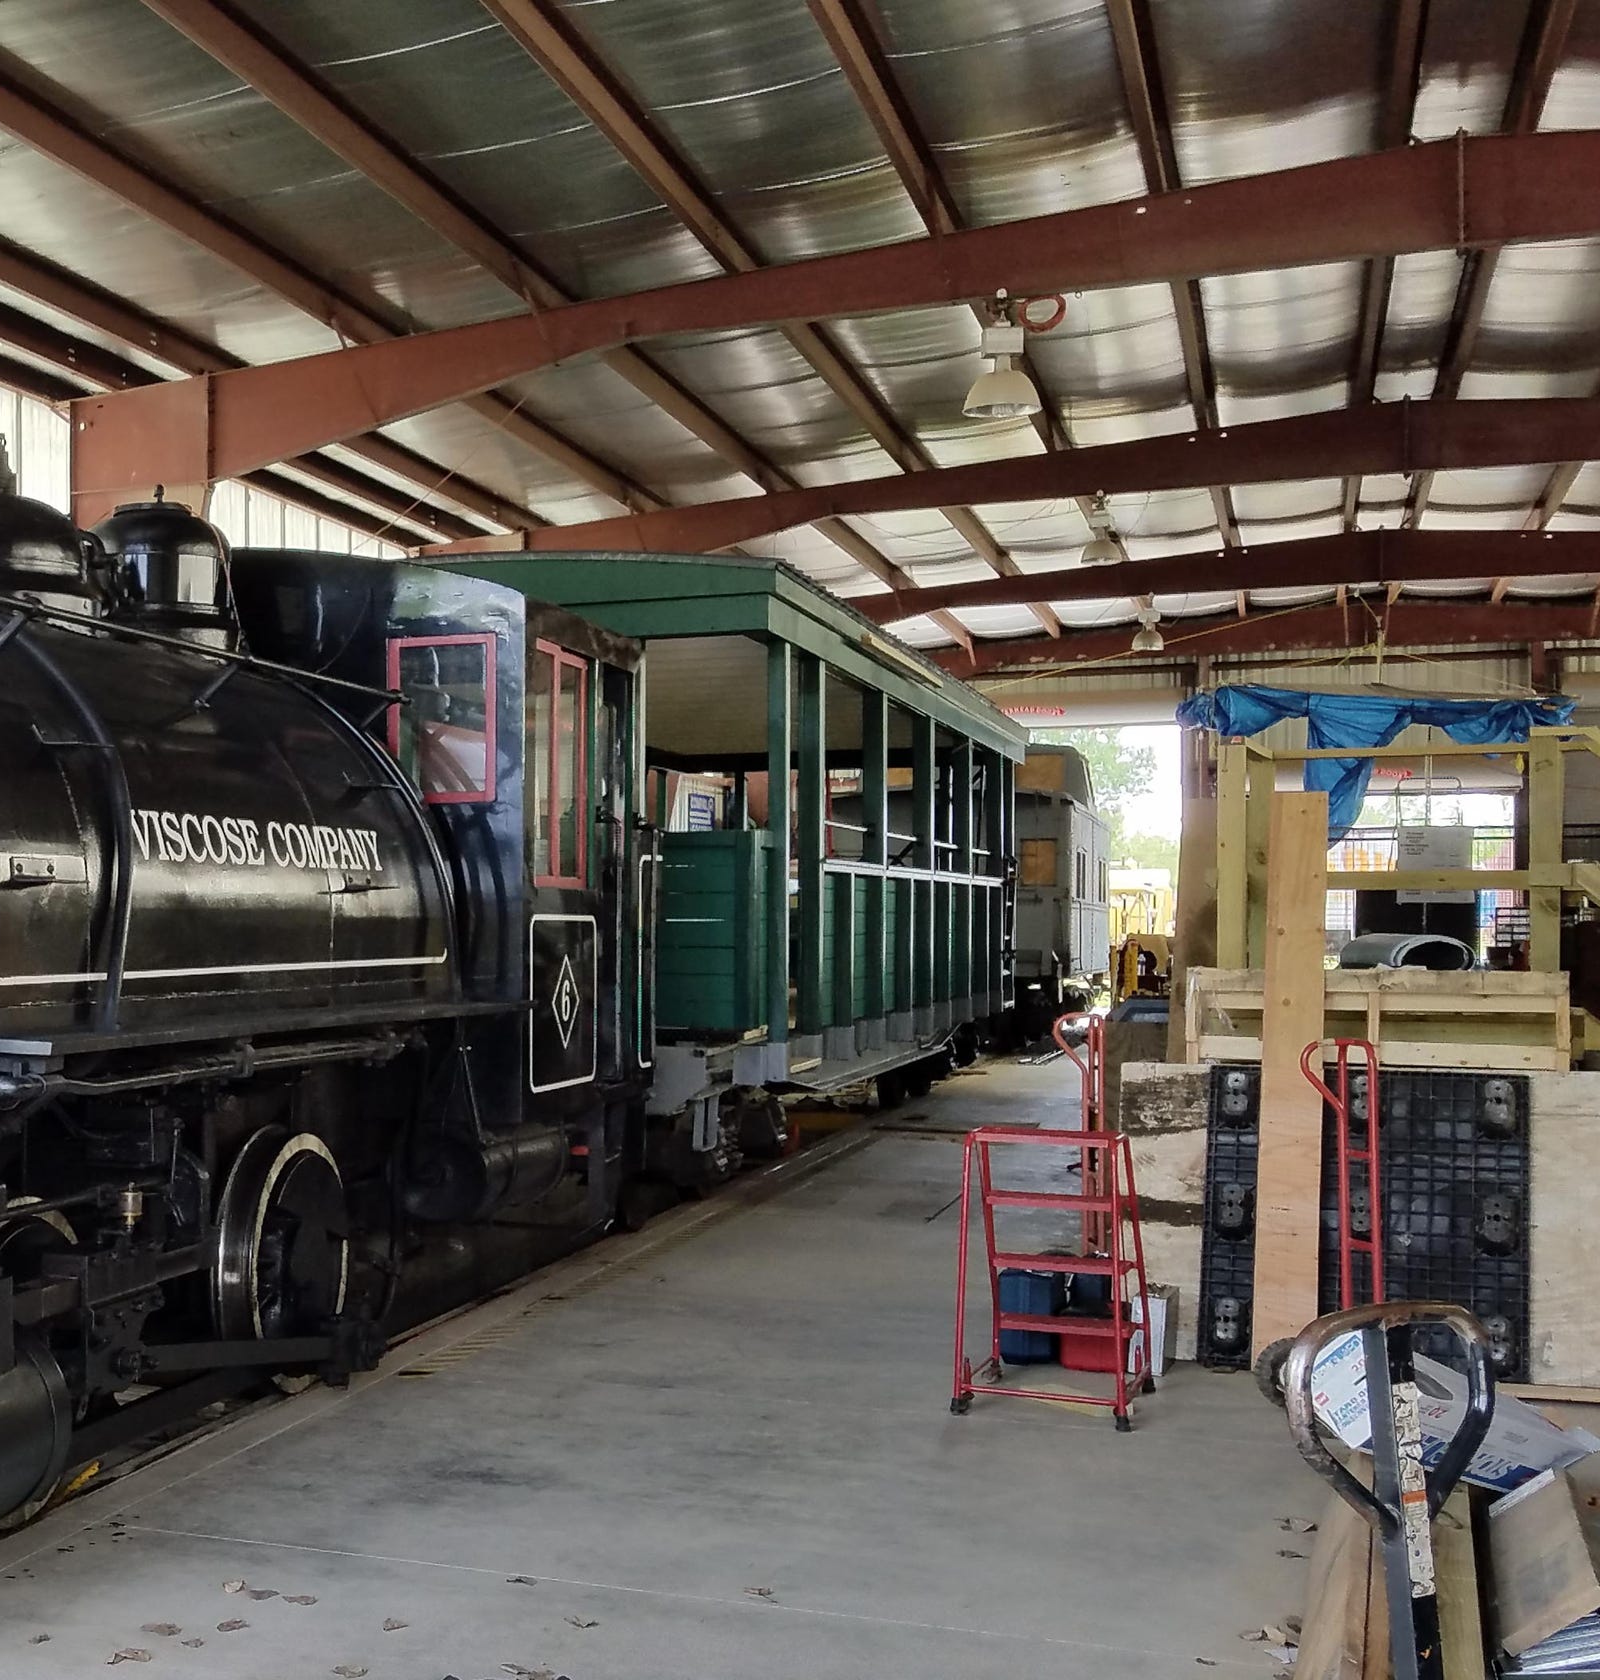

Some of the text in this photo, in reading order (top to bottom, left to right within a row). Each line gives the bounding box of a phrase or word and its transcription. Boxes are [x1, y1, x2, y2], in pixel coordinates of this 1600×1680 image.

[130, 808, 384, 872] VISCOSE COMPANY
[562, 979, 571, 1022] 6
